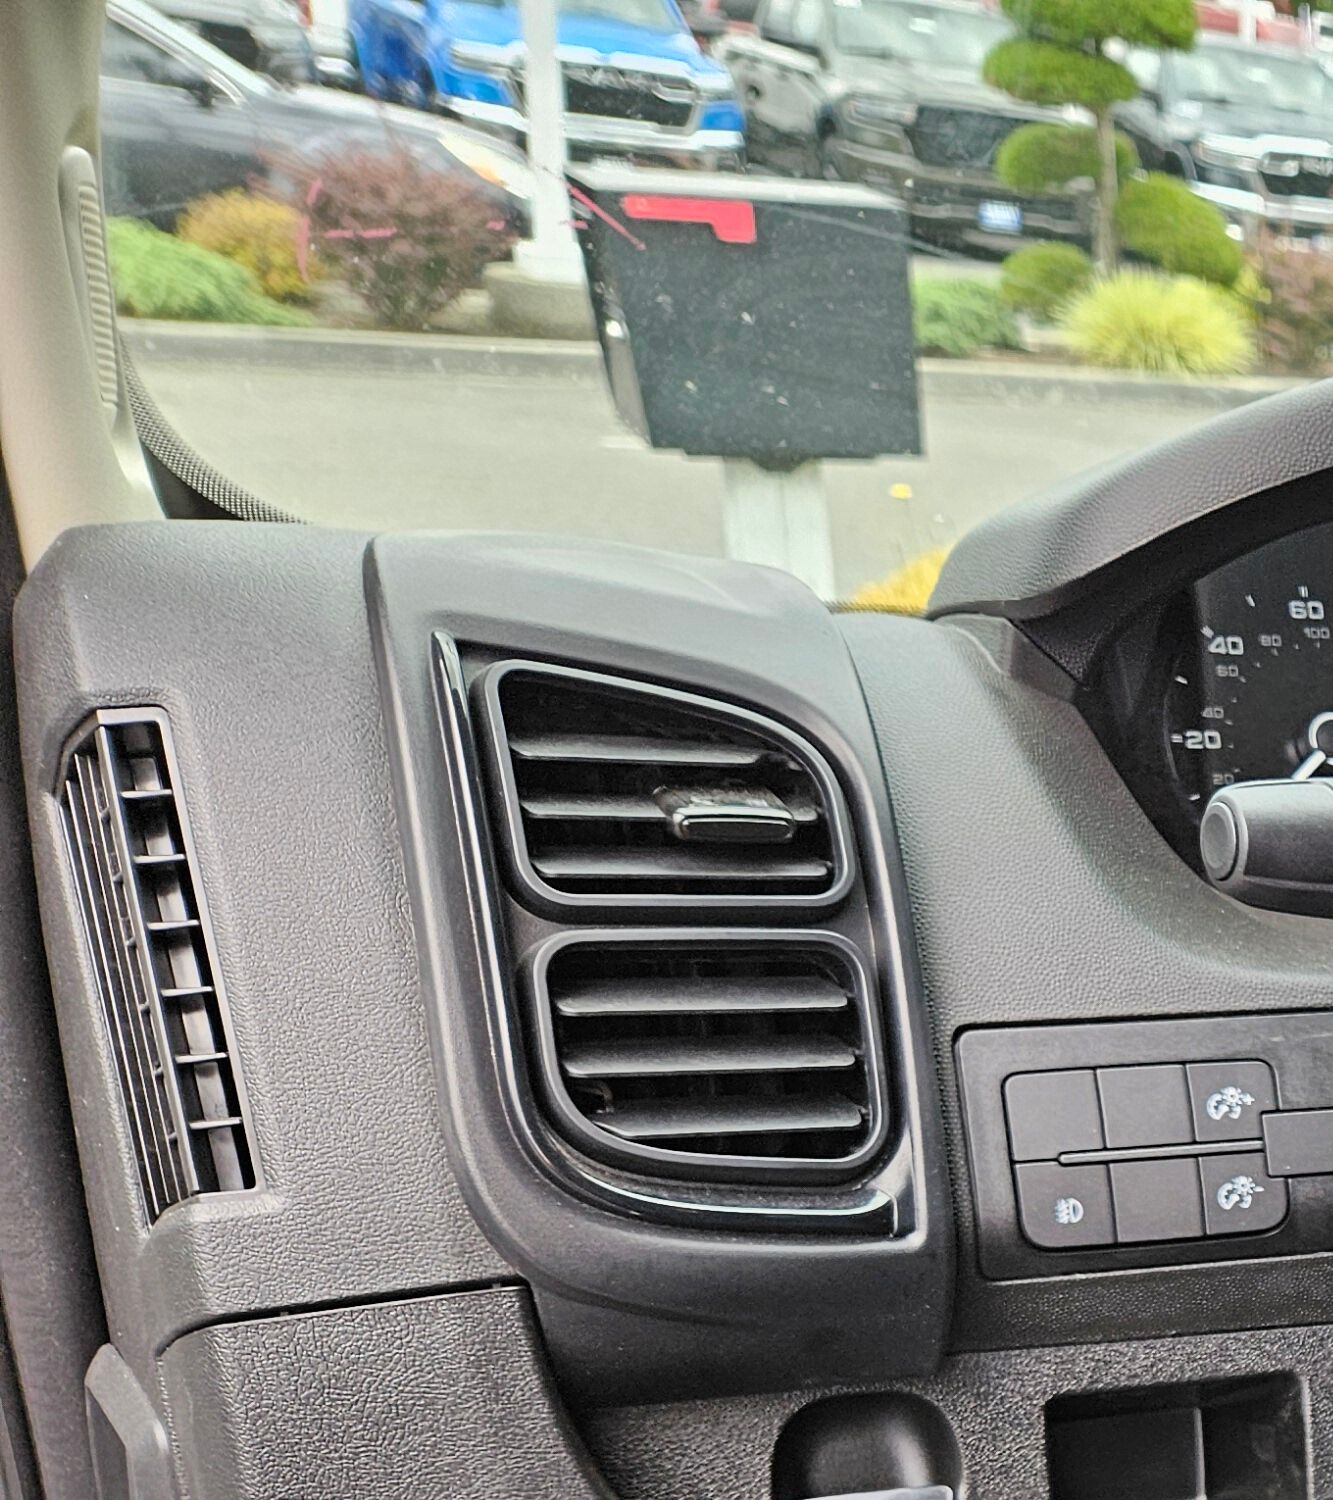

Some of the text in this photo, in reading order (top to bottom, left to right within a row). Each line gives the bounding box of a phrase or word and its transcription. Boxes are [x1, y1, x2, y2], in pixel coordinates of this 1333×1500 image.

[1289, 600, 1324, 620] 60
[1304, 627, 1330, 639] 100
[1208, 636, 1244, 655] 40
[1202, 707, 1224, 719] 40
[1185, 730, 1222, 750] 20
[1212, 773, 1235, 785] 20
